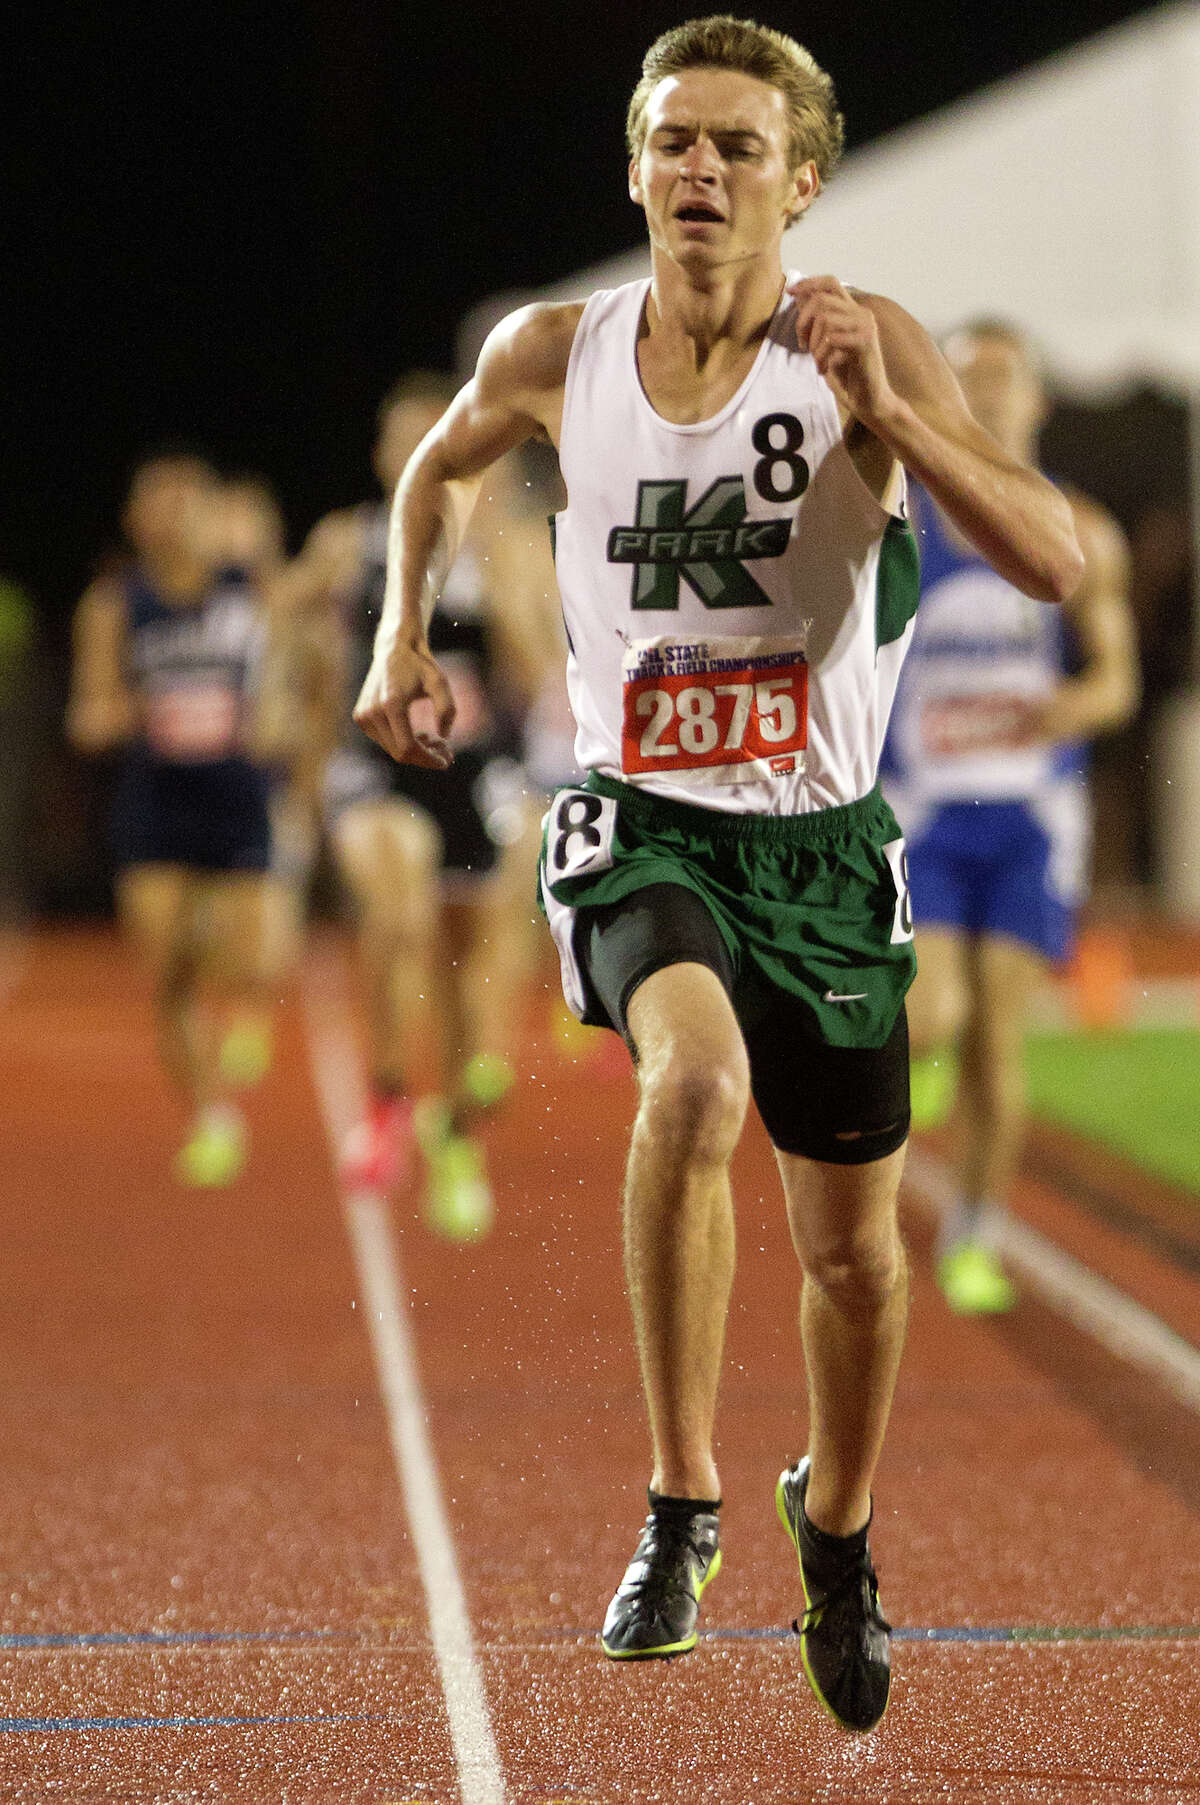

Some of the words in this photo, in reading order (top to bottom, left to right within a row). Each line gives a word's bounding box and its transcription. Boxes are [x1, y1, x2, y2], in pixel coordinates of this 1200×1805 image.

[752, 412, 809, 503] 8
[631, 474, 774, 611] K
[626, 661, 664, 682] TRACK
[677, 660, 707, 676] FIELD
[709, 651, 807, 673] CHAMPIONSHIPS
[665, 644, 709, 662] STATE
[636, 678, 796, 758] 2875
[553, 794, 602, 870] 8
